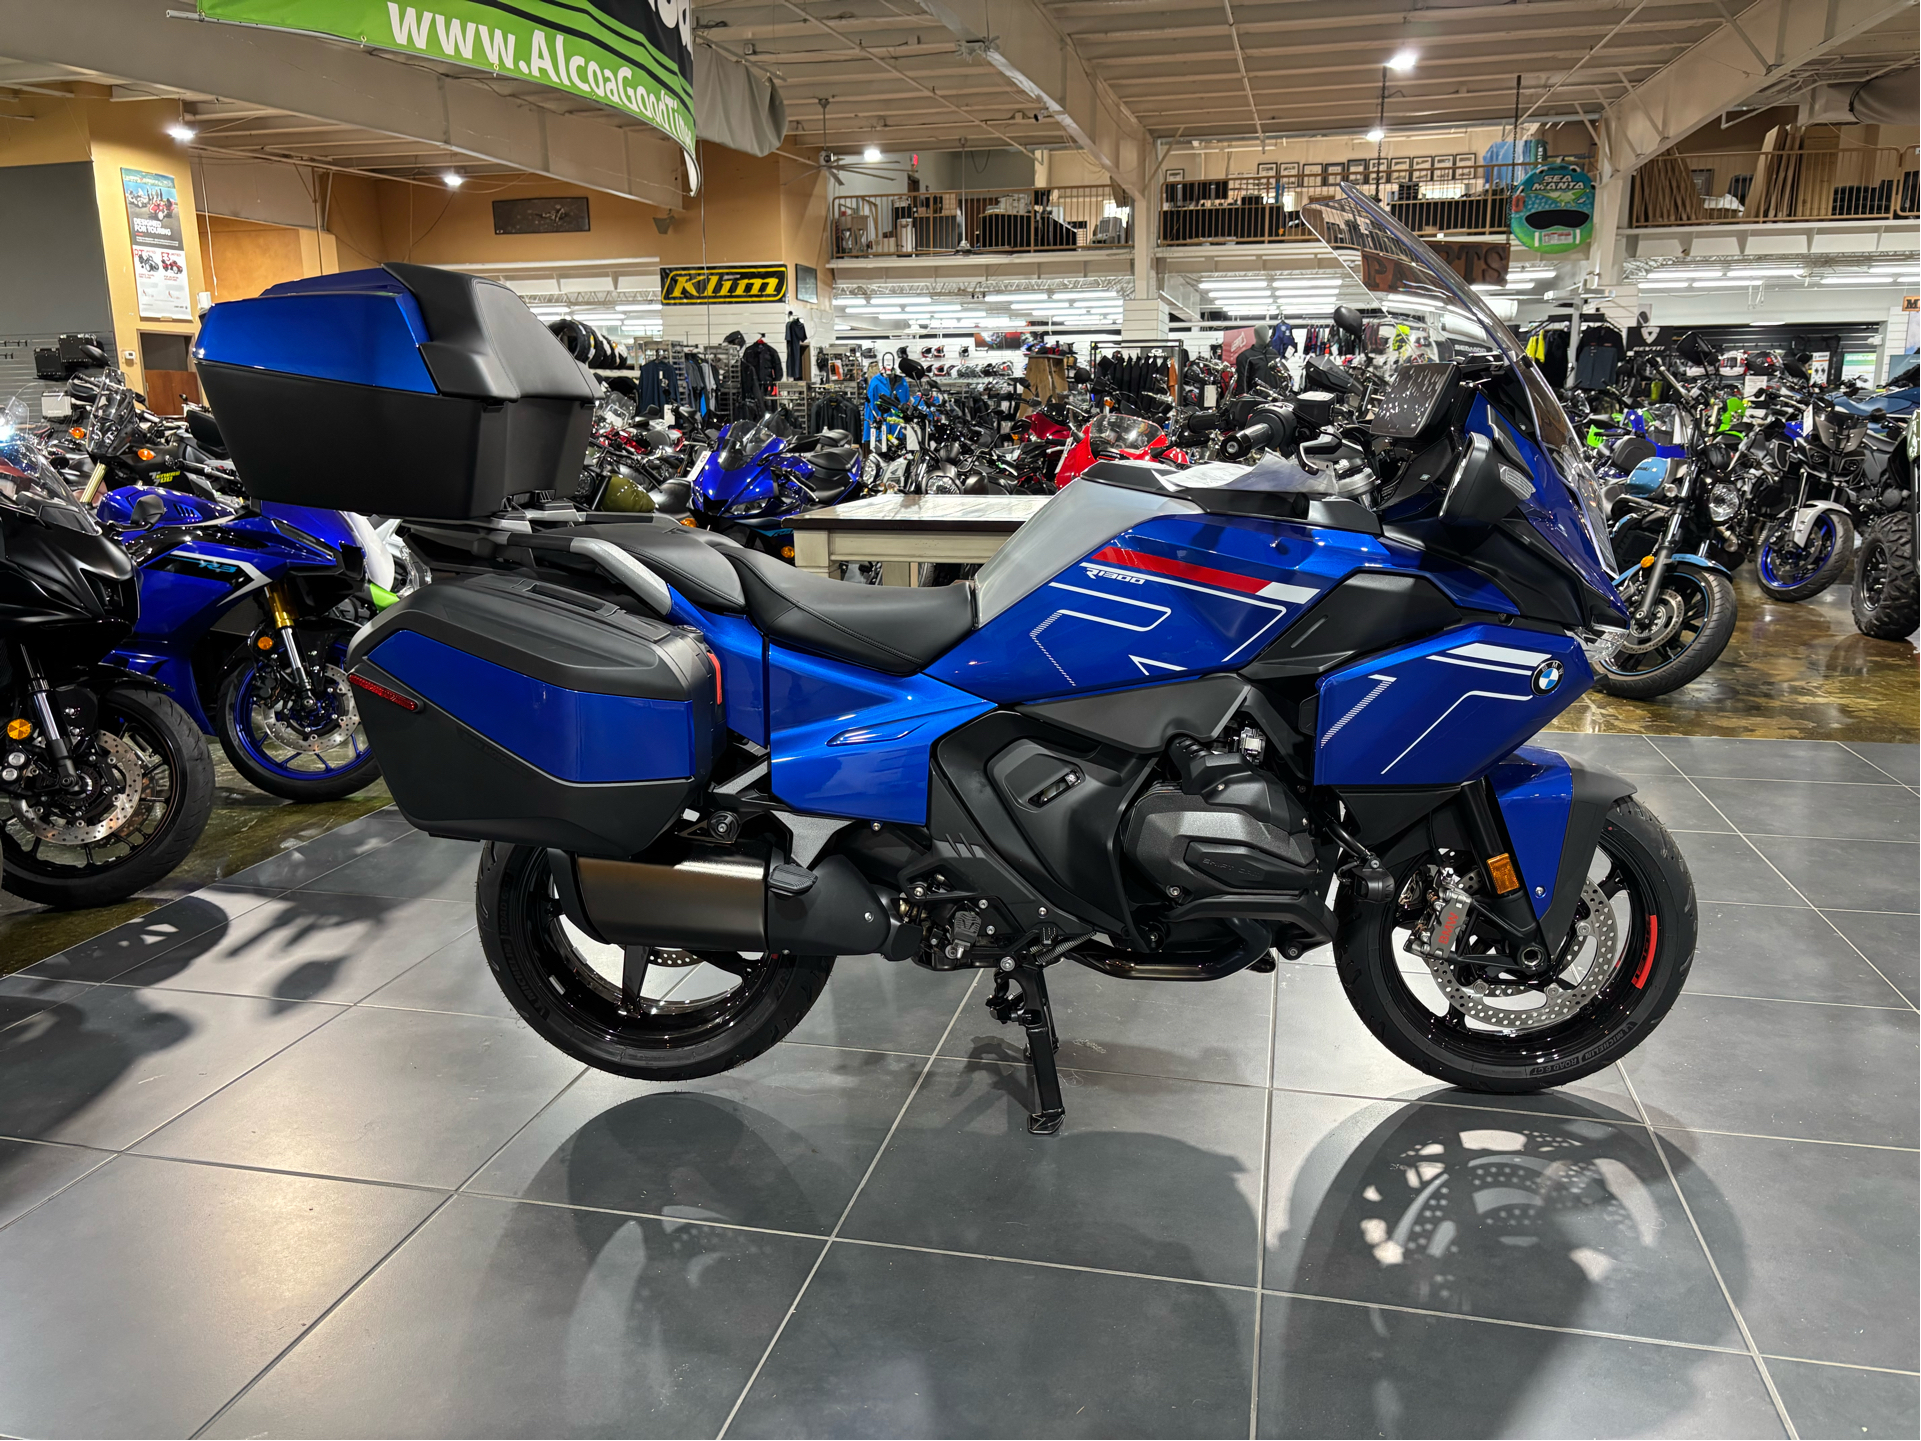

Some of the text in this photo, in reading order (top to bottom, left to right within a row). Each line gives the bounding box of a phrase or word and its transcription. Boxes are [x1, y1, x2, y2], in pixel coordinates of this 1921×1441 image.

[1531, 182, 1584, 191] MANTA
[1543, 175, 1572, 183] SEA
[133, 217, 161, 228] DESIGNED
[134, 225, 171, 236] FOR TOURING
[669, 274, 779, 298] Klim
[1084, 567, 1146, 585] R1300
[1438, 911, 1459, 945] BMW
[503, 943, 536, 1001] MICHELIN
[1584, 1032, 1624, 1060] MICHELIN
[1553, 1058, 1577, 1071] ROAD
